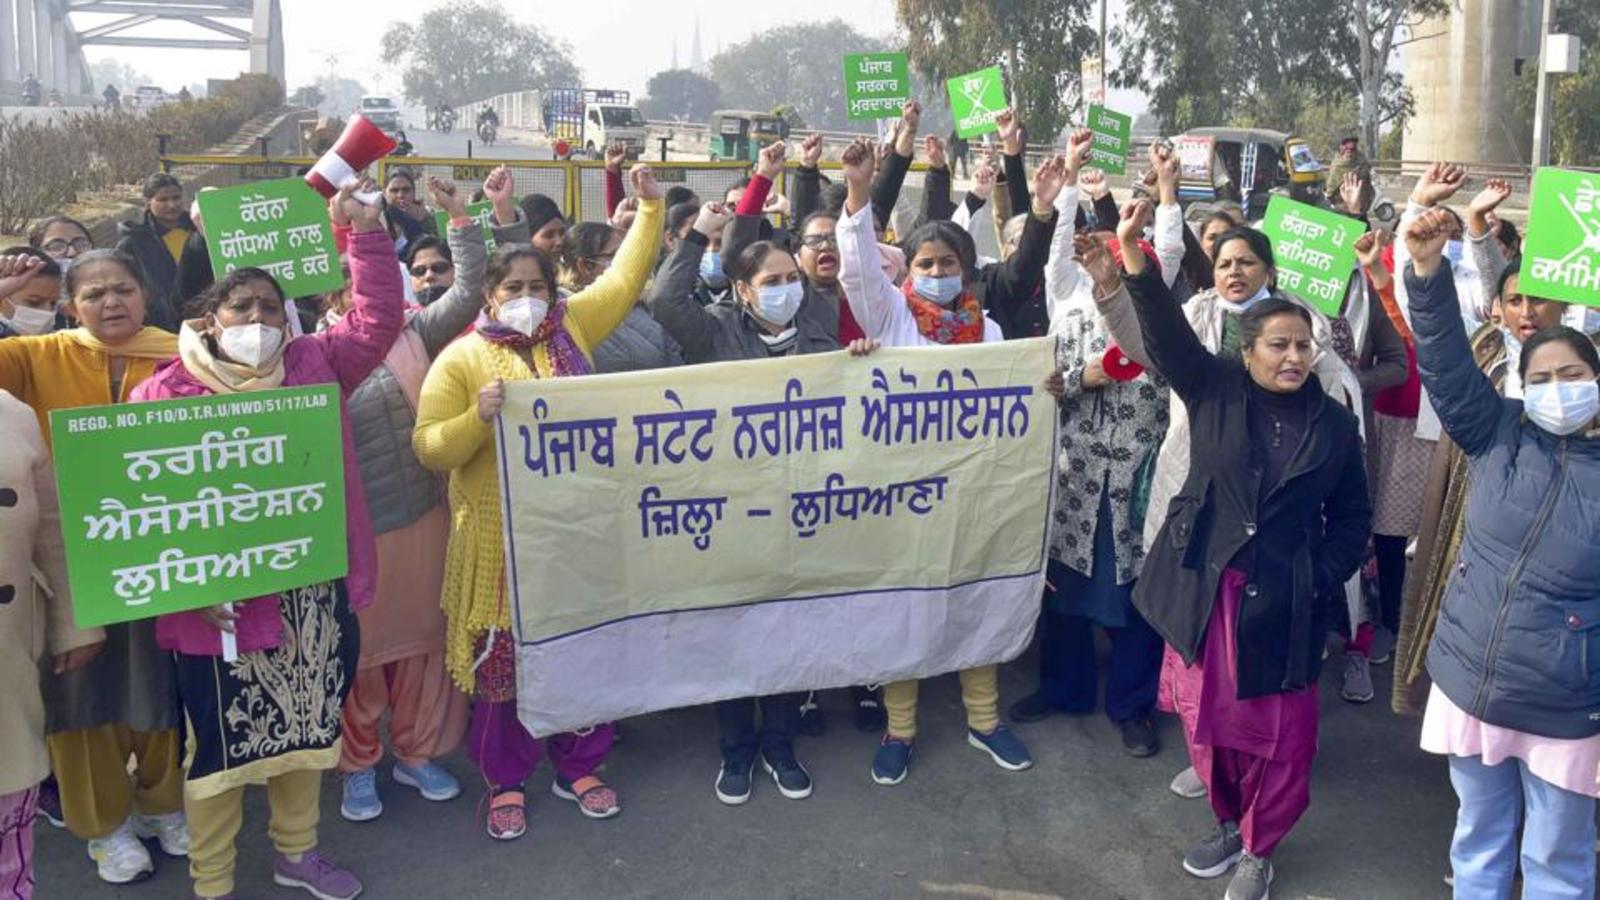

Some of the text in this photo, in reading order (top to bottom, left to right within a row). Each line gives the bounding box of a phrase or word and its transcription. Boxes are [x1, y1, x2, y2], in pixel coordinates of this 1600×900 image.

[858, 56, 893, 75] ਪੰਜਾਬ
[856, 79, 899, 93] ਸਰਕਾਰ
[240, 194, 289, 222] ਕੋਰੋਨਾ
[219, 223, 323, 258] ਯੋਧਿਆ ਨਾਲ
[1280, 210, 1347, 248] ਲੰਗੜਾ ਪੇ
[300, 246, 329, 275] ਕਰੋ
[1307, 277, 1344, 302] ਨਹੀਂ
[68, 394, 328, 433] REGD. NO. F10/D.T.R.U/NWD/51/17/LAB
[519, 397, 617, 477] ਪੰਜਾਬ
[633, 389, 717, 465] ਸਟੇਟ
[731, 378, 846, 460] ਨਰਸਿਜ਼
[123, 426, 288, 481] ਨਰਸਿੰਗ
[83, 482, 327, 541] ਐਸੋਸੀਏਸ਼ਨ
[638, 486, 728, 550] ਜ਼ਿਲ੍ਹਾ
[791, 472, 949, 538] ਲੁਧਿਆਣਾ
[111, 537, 313, 606] ਲੁਧਿਆਣਾ
